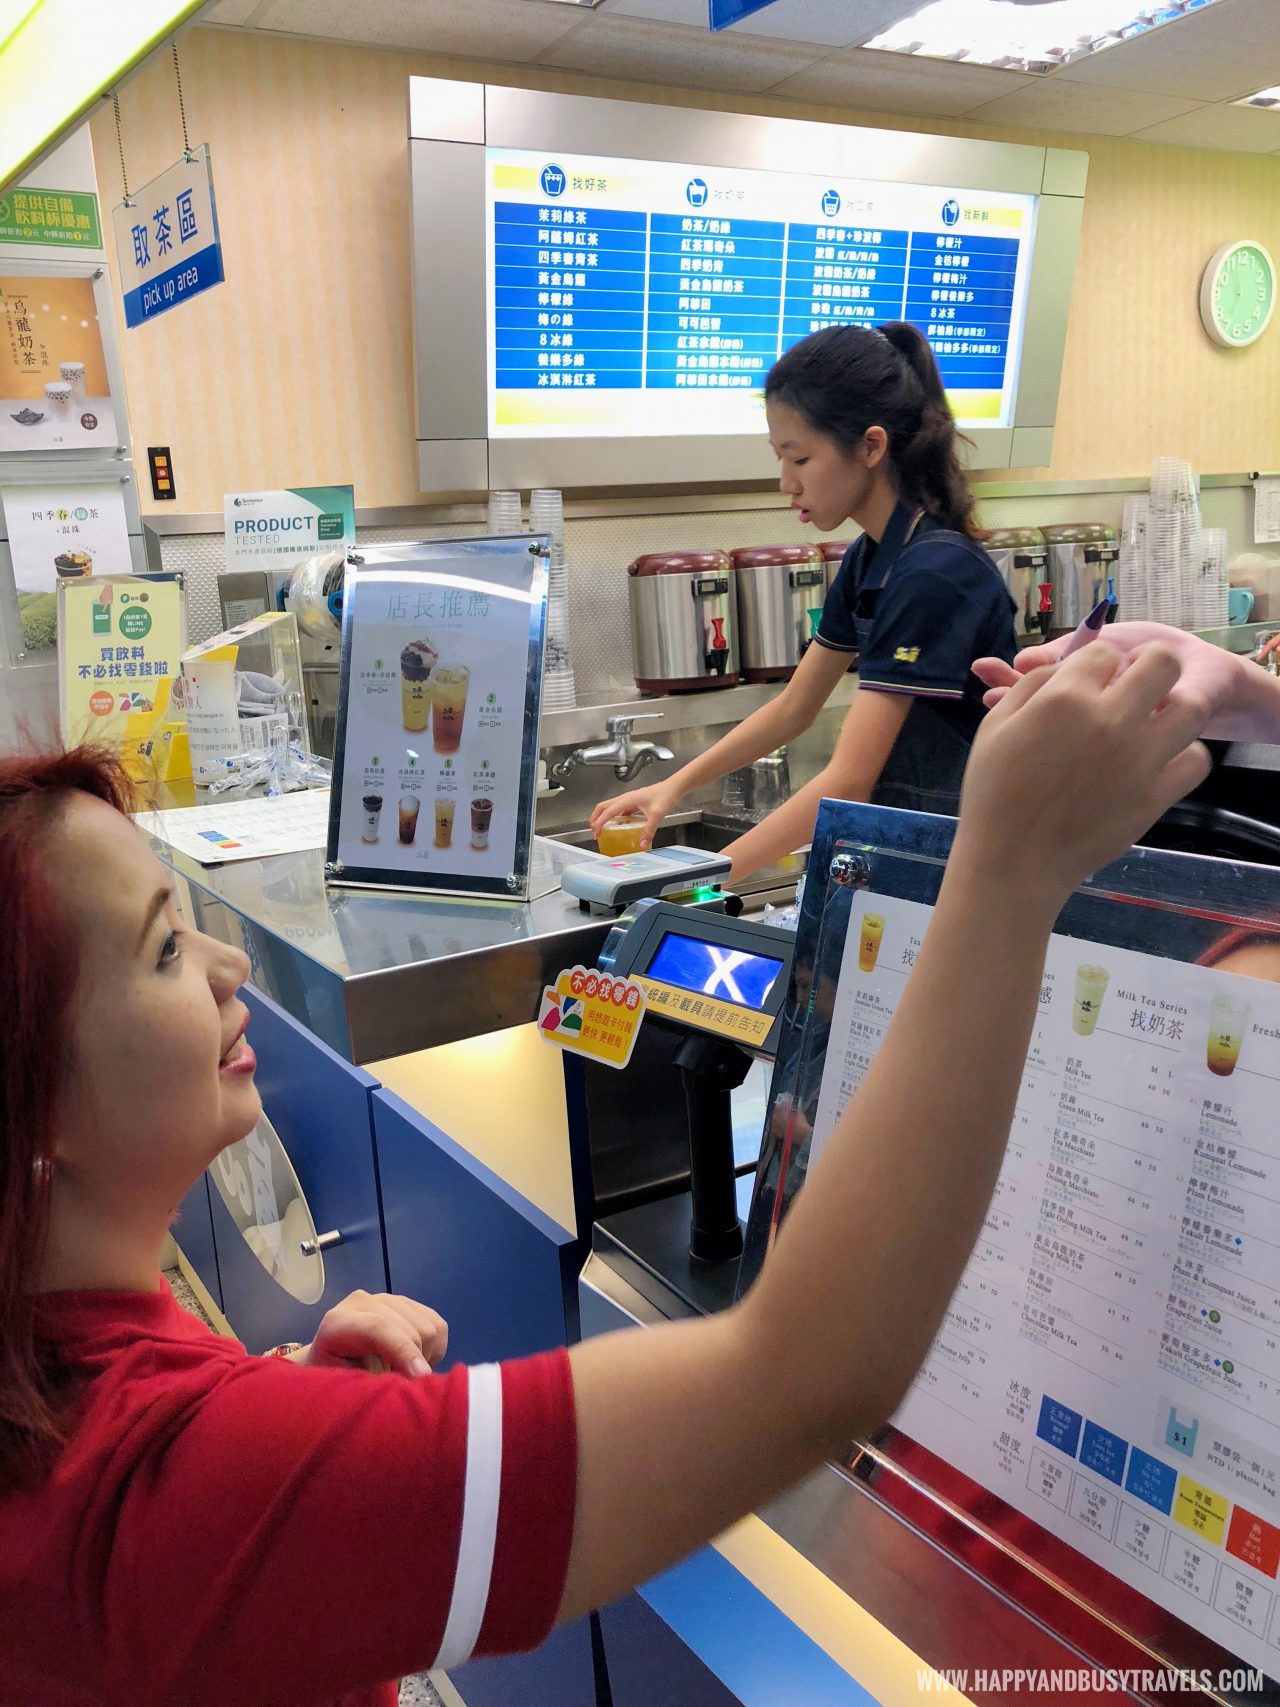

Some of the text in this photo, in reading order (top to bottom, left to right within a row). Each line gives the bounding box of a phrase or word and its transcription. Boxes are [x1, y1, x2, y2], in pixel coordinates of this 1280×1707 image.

[572, 177, 607, 191] 找好茶
[13, 194, 74, 213] 提供自備
[15, 209, 91, 230] 飲料杯優惠
[538, 208, 587, 224] 茉莉綠茶
[131, 187, 199, 270] 取茶區
[538, 250, 599, 267] 四季春青茶
[143, 265, 199, 311] pick up area
[13, 299, 37, 366] 烏龍奶茶
[234, 515, 314, 534] PRODUCT
[234, 534, 281, 546] TESTED
[387, 590, 490, 621] 店長推薦
[100, 645, 145, 662] 買飲料
[78, 660, 169, 679] 不必找零錢啦
[572, 974, 639, 1008] 不必找零錢
[1116, 989, 1188, 1015] Milk Tea Series
[587, 1009, 633, 1034] 用悠遊卡付錢
[1129, 1008, 1185, 1040] 找奶茶
[1252, 1023, 1280, 1039] Fresh
[581, 1024, 598, 1040] 更快
[1065, 1066, 1092, 1080] Milk Tea
[1151, 1066, 1158, 1074] M
[1077, 1108, 1091, 1118] Milk
[1093, 1113, 1105, 1123] Tea
[1201, 1109, 1238, 1127] Lemonade
[1053, 1136, 1063, 1147] Tea
[1065, 1141, 1095, 1158] Macchiato
[1228, 1160, 1266, 1179] Lemonade
[1068, 1181, 1099, 1199] Macchiato
[1187, 1187, 1205, 1200] Plum
[1208, 1194, 1245, 1214] Lemonade
[1080, 1224, 1093, 1236] Milk
[1096, 1231, 1107, 1241] Tea
[1181, 1225, 1204, 1241] Yakult
[1205, 1236, 1243, 1256] Lemonade
[1056, 1252, 1069, 1264] Milk
[1237, 1292, 1256, 1306] Juice
[1051, 1327, 1064, 1340] Milk
[1066, 1335, 1077, 1347] Tea
[1203, 1320, 1223, 1335] Juice
[1223, 1373, 1243, 1388] Juice
[1009, 1380, 1031, 1401] 冰度
[999, 1431, 1021, 1454] 甜度
[1235, 1468, 1261, 1488] plastic
[1262, 1483, 1277, 1498] bag
